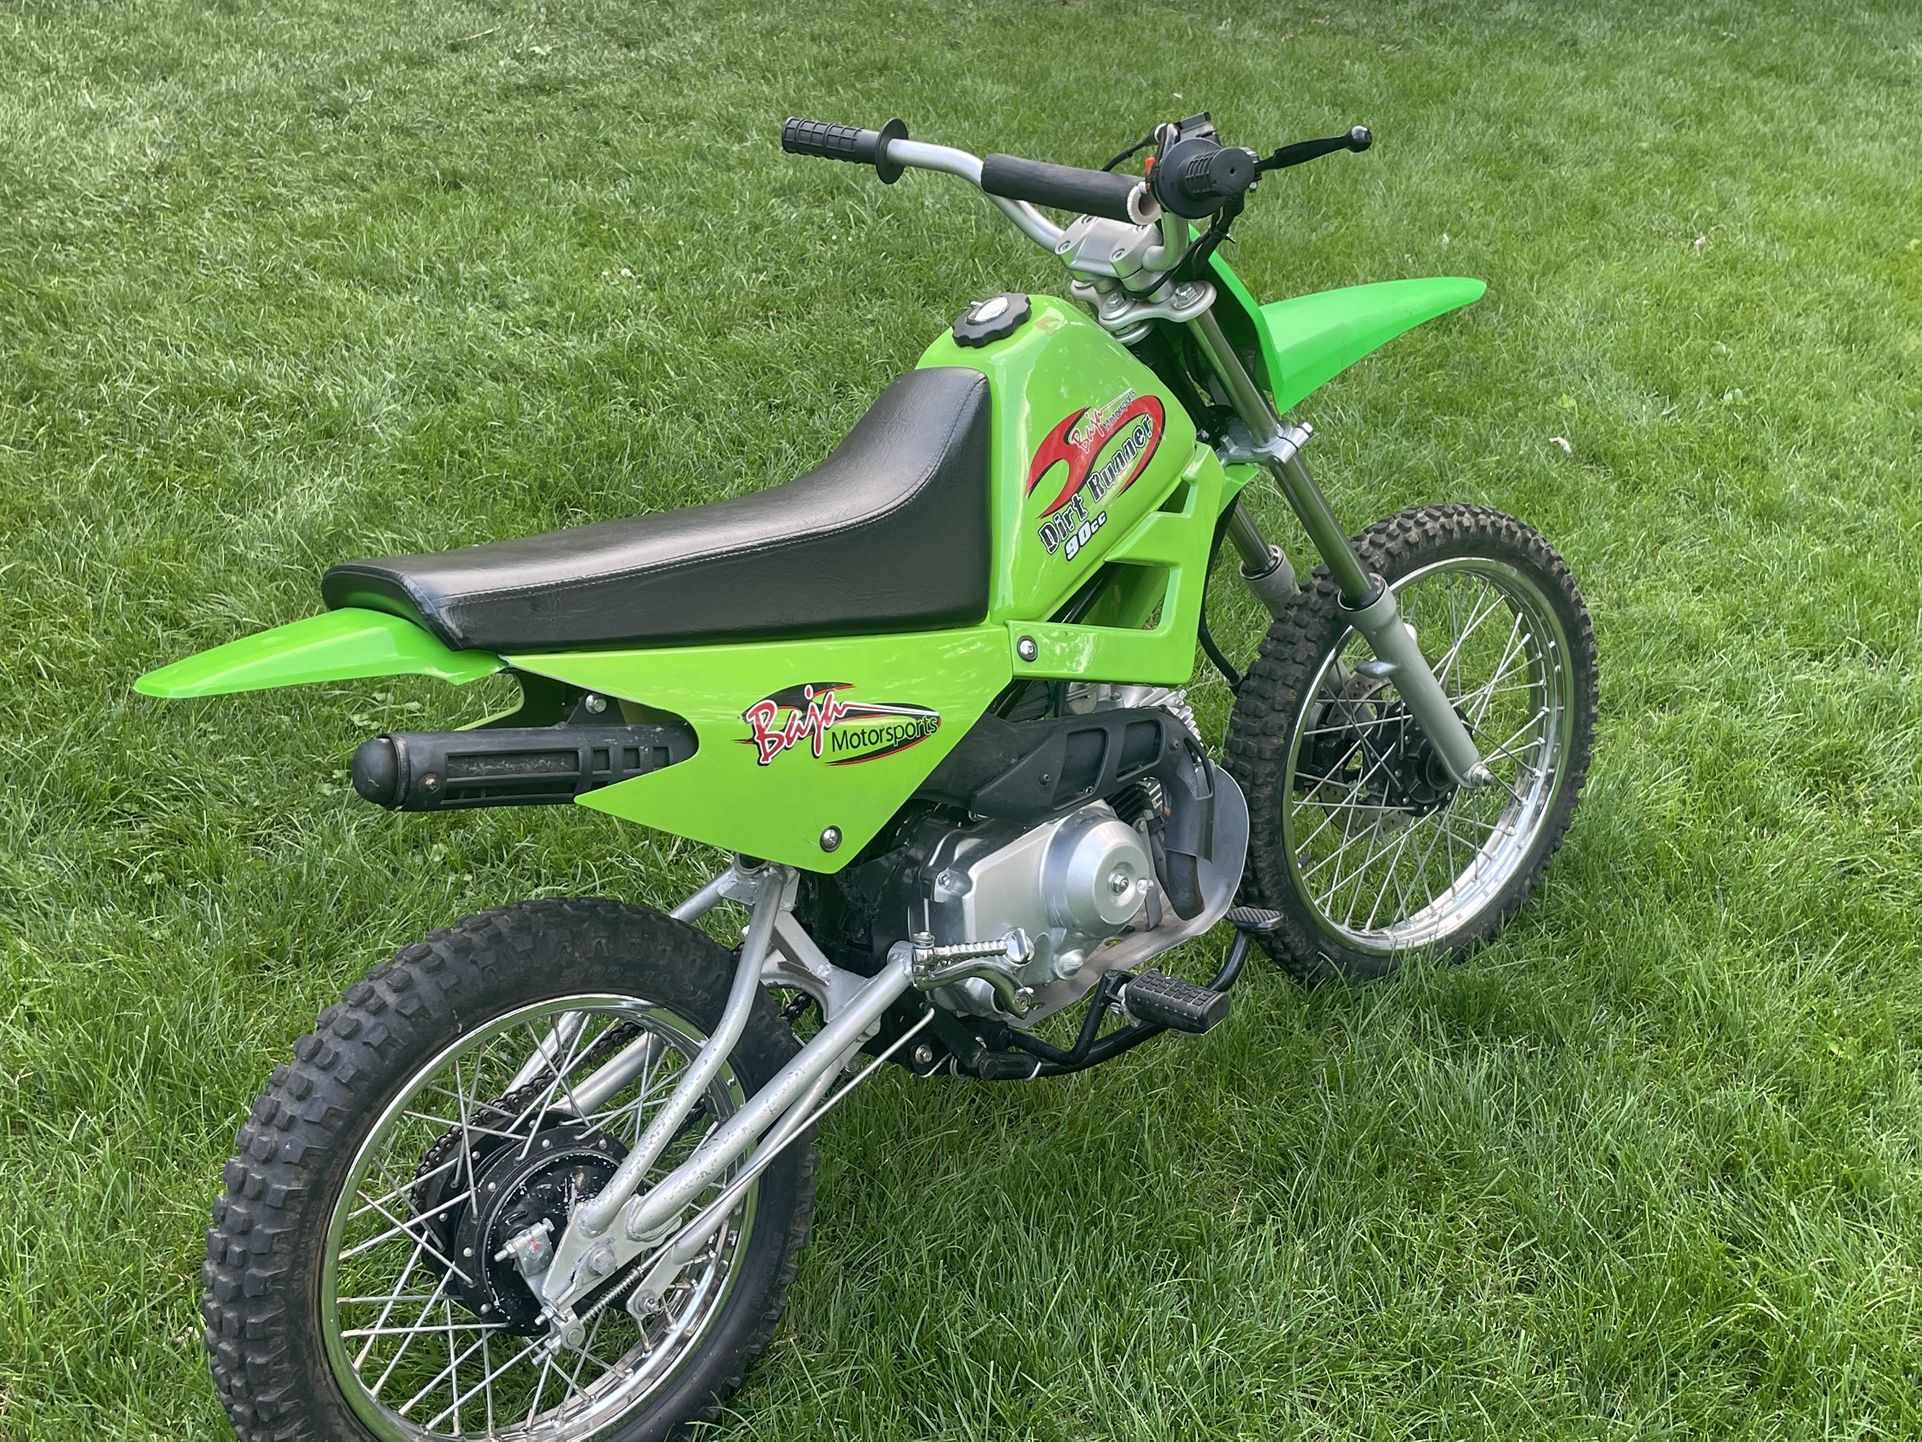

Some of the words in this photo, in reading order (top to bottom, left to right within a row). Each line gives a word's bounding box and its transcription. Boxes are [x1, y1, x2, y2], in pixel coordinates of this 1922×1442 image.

[1070, 409, 1105, 452] Baja
[1103, 390, 1137, 430] Motorsports
[1038, 493, 1088, 553] Dirt
[1086, 415, 1152, 502] Runner
[1064, 511, 1107, 561] 90cc
[745, 685, 851, 765] Baja
[831, 715, 939, 754] Motorsports
